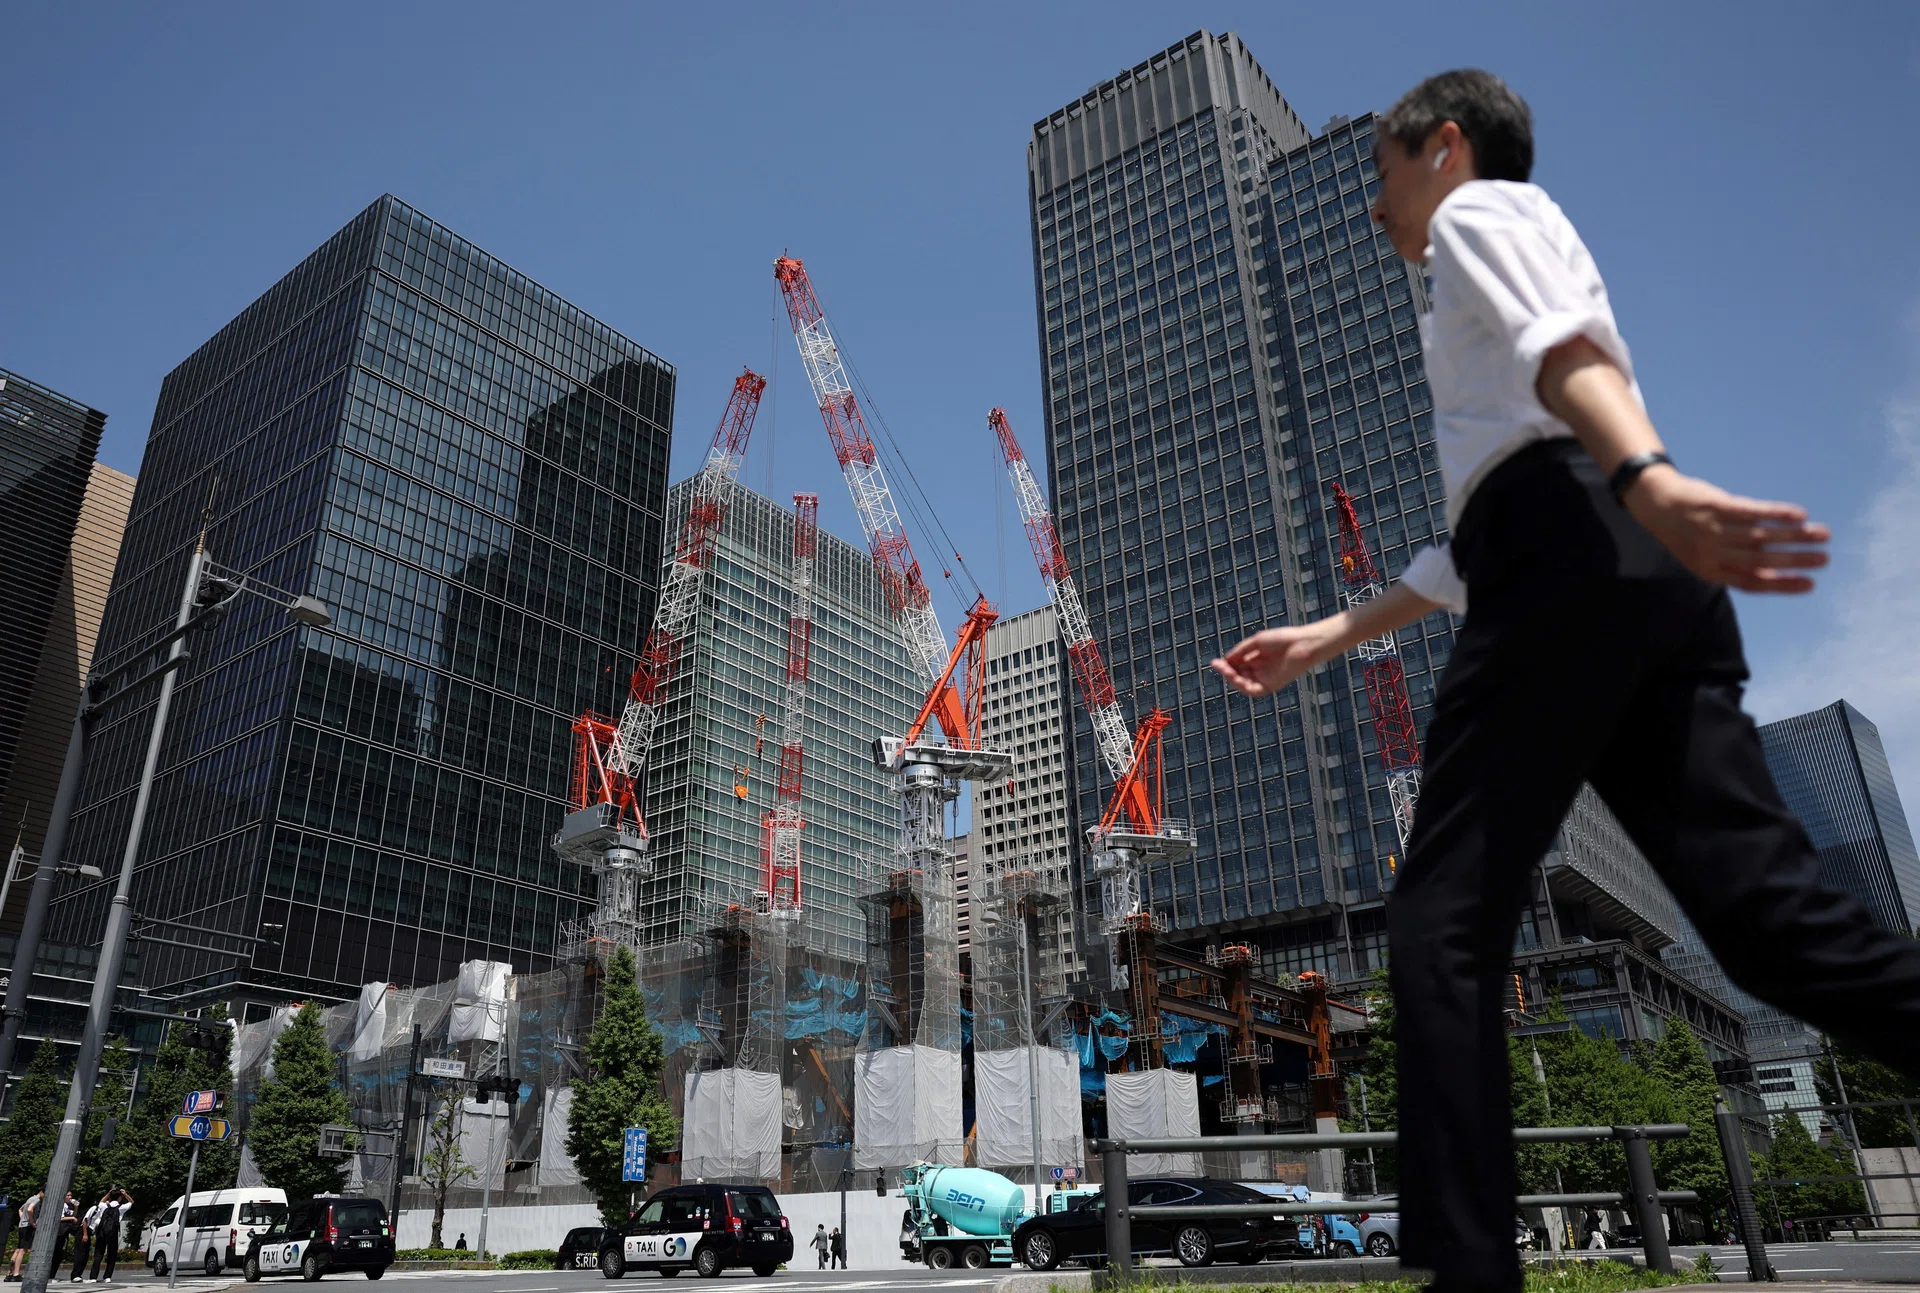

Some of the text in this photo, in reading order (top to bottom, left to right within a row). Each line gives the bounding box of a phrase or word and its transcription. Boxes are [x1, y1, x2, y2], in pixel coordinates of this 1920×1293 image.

[432, 1061, 462, 1071] 和田倉門
[190, 1095, 195, 1108] 1
[636, 1133, 646, 1177] 和田倉門
[262, 1244, 299, 1264] TAXI GO
[636, 1236, 687, 1257] TAXI GO
[575, 1256, 598, 1268] S.RID
